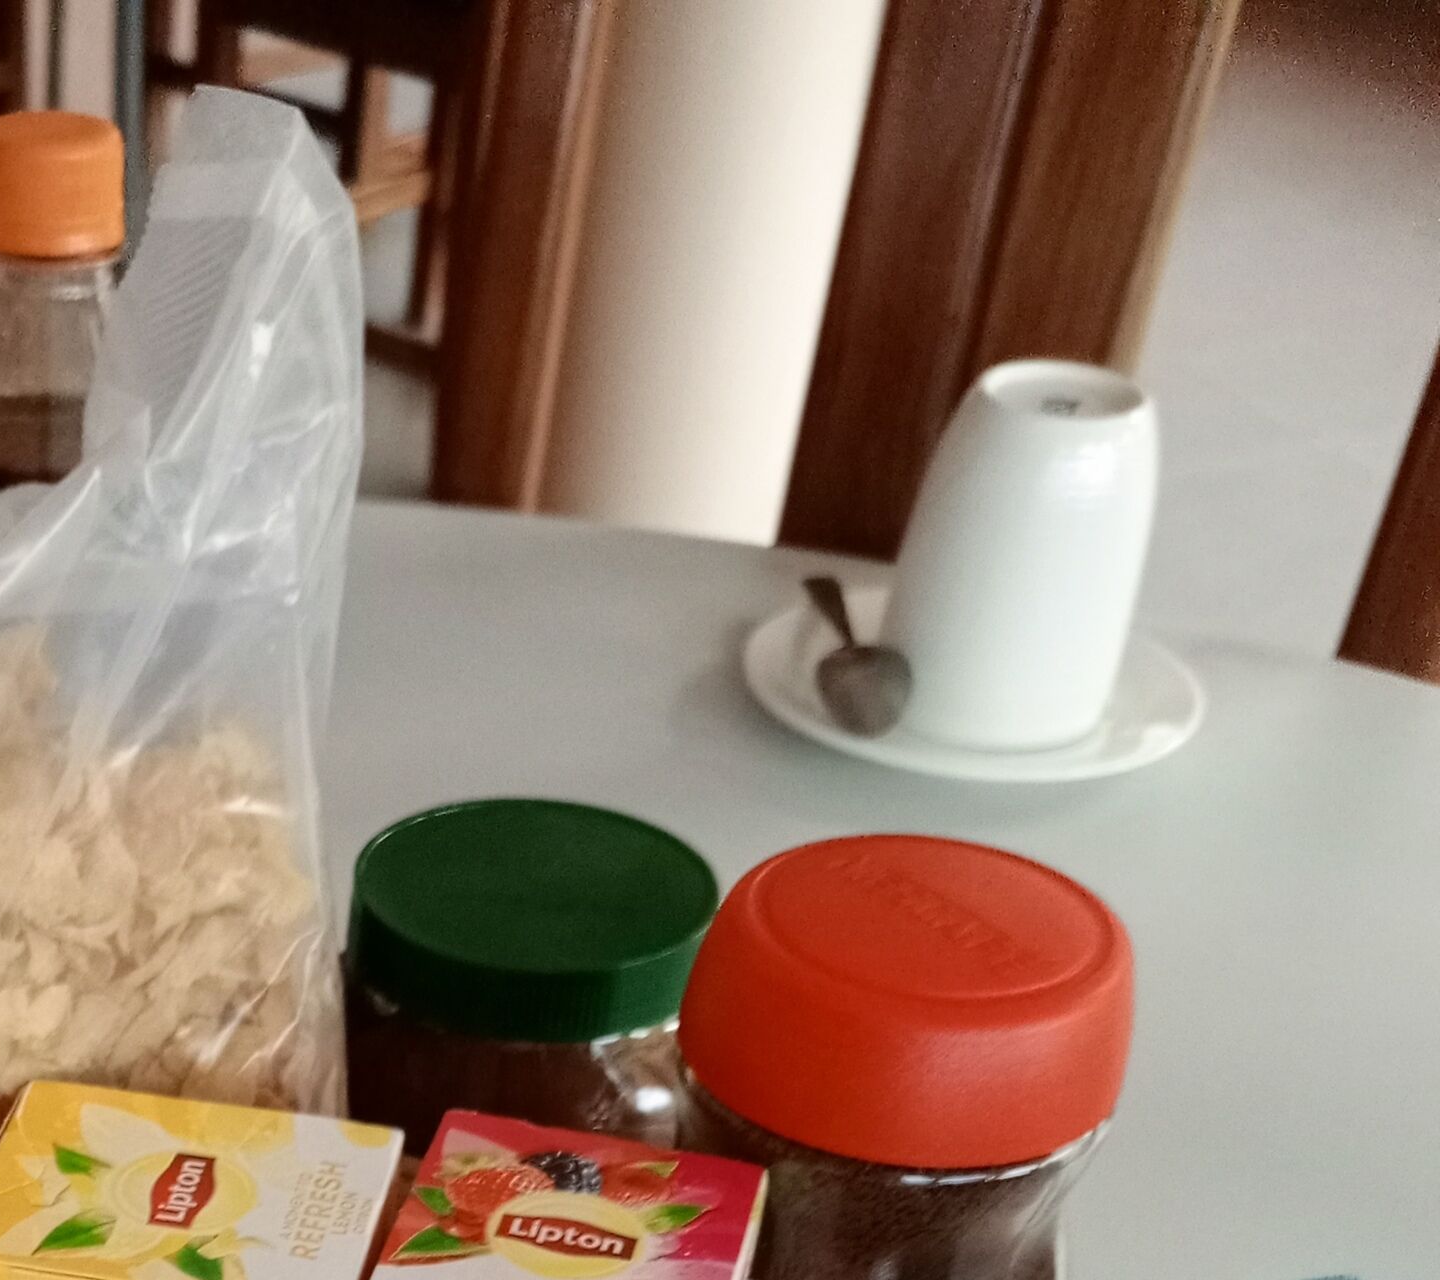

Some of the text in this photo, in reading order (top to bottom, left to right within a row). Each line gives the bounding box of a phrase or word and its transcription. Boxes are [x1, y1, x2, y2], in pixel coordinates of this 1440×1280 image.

[155, 1158, 208, 1224] Lipton
[289, 1160, 349, 1261] REFRESH
[508, 1216, 625, 1256] Lipton
